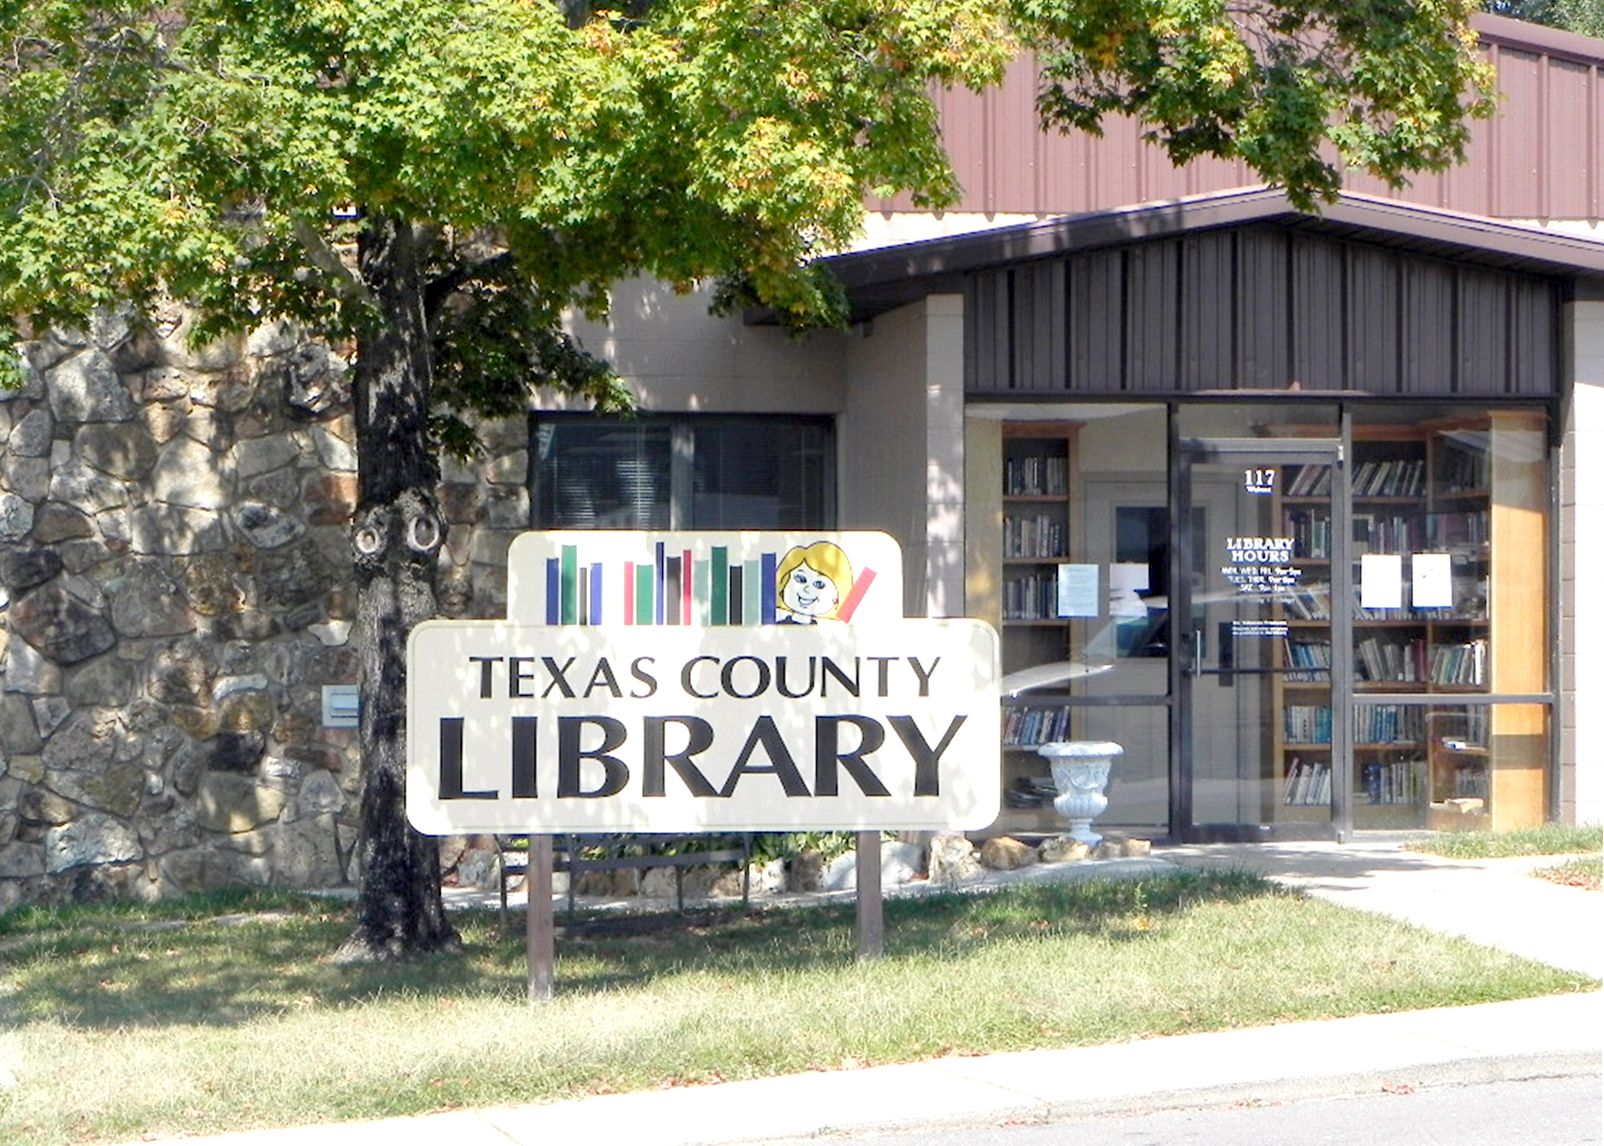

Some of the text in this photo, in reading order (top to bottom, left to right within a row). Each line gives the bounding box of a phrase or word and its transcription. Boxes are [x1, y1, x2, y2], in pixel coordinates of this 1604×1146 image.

[1244, 469, 1275, 486] 117
[1226, 537, 1295, 550] LIBRARY
[1231, 550, 1290, 563] HOURS
[469, 655, 942, 700] TEXAS COUNTY
[437, 714, 968, 800] LIBRARY
